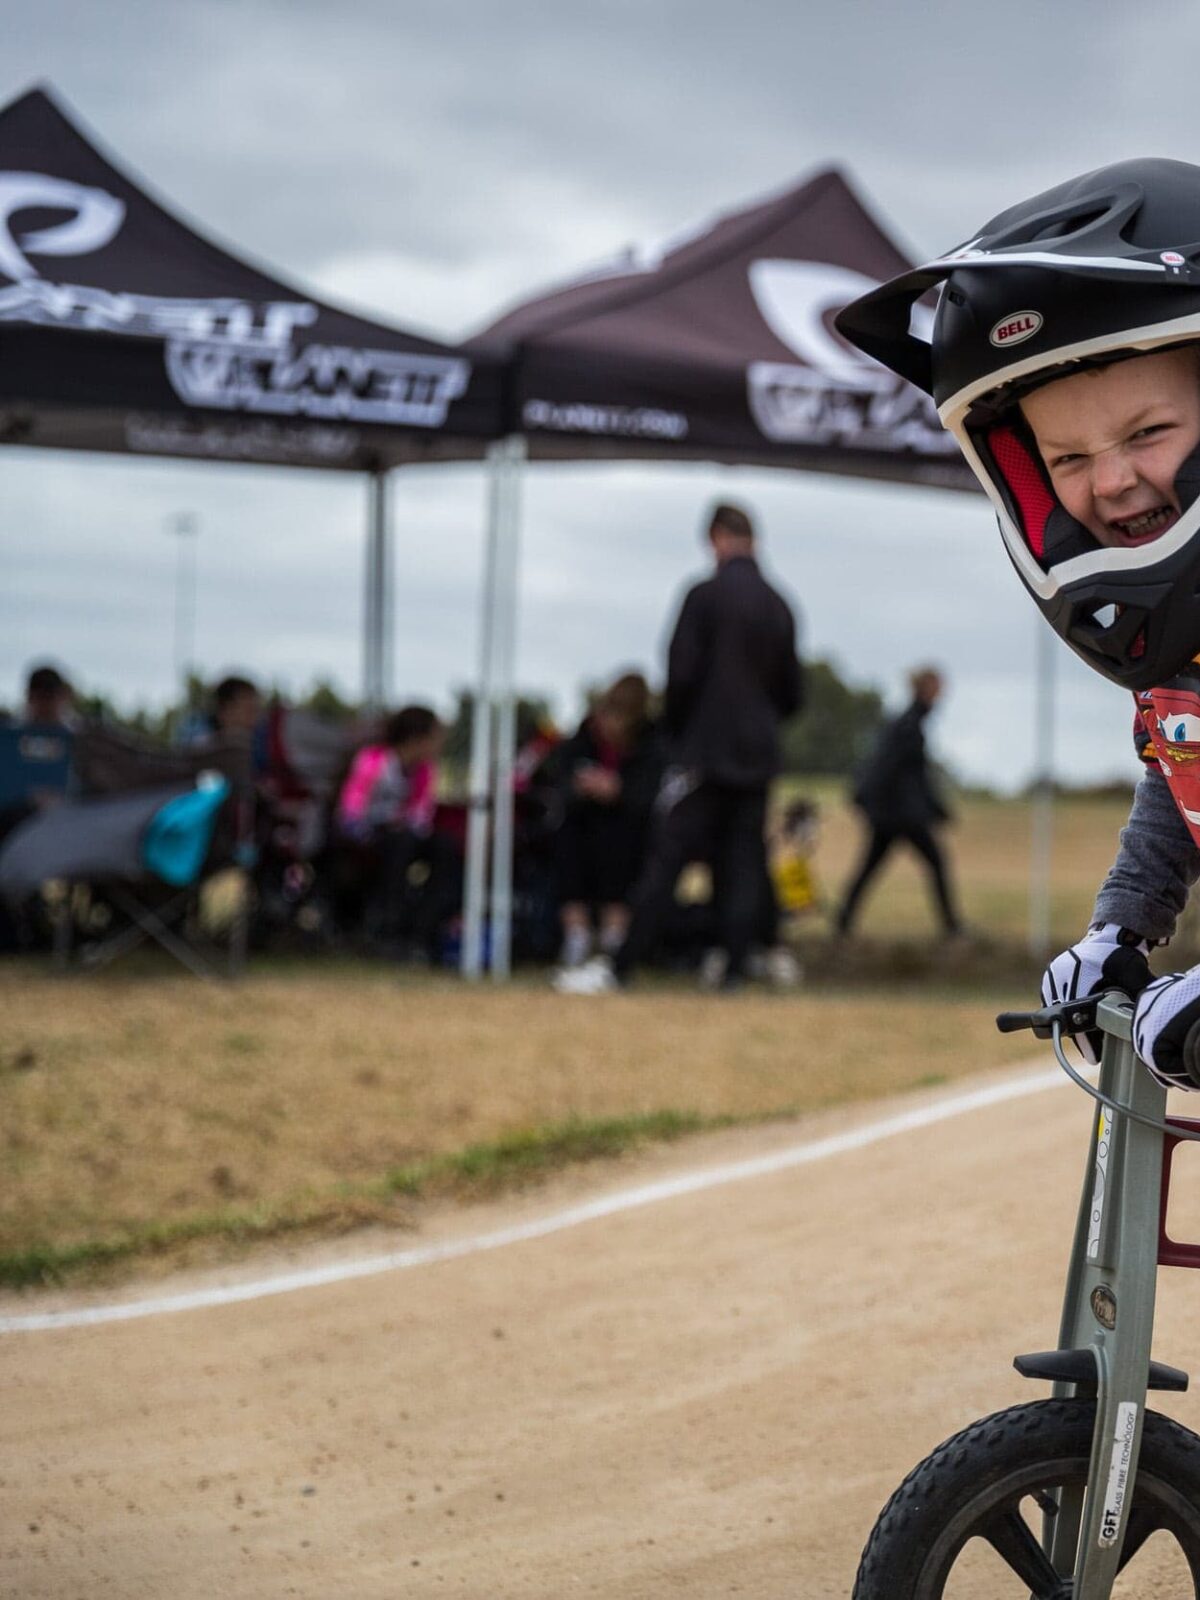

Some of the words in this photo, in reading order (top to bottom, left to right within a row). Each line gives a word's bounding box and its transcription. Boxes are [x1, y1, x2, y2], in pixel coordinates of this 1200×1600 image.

[996, 317, 1036, 342] BELL
[1120, 1411, 1135, 1467] TECHNOLOGY
[1117, 1468, 1127, 1490] FIBRE
[1102, 1508, 1117, 1539] GFT
